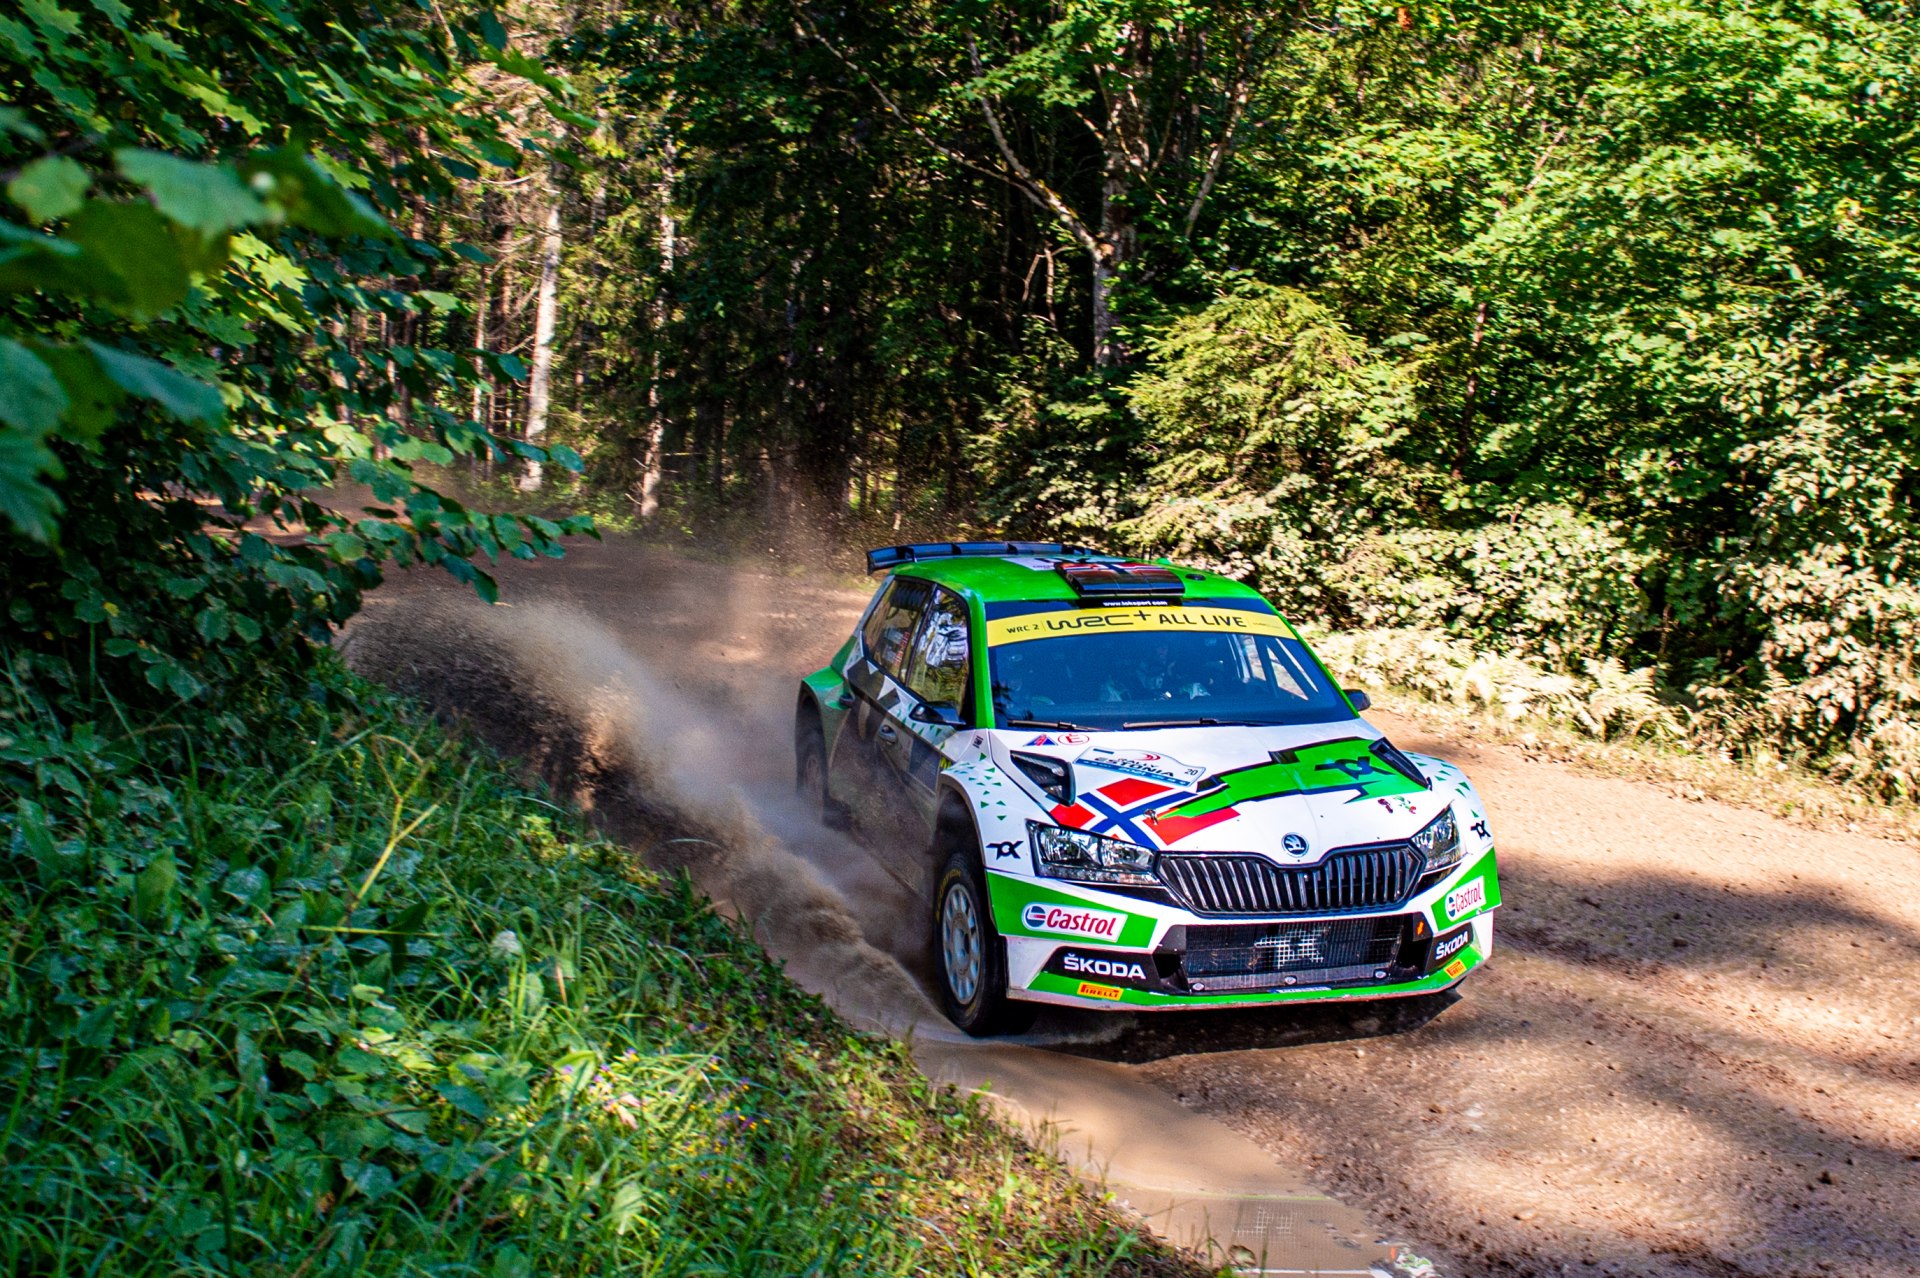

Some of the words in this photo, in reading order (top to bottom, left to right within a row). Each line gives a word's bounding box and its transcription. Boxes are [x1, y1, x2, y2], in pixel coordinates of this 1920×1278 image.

[1007, 625, 1029, 634] WRC
[1160, 614, 1197, 625] ALL
[1200, 614, 1247, 627] LIVE
[1185, 768, 1199, 776] 20
[1456, 882, 1482, 913] Castrol
[1046, 908, 1117, 936] Castrol
[1435, 931, 1469, 960] ŠKODA
[1063, 953, 1147, 980] ŠKODA
[1081, 984, 1120, 998] PIRELLI
